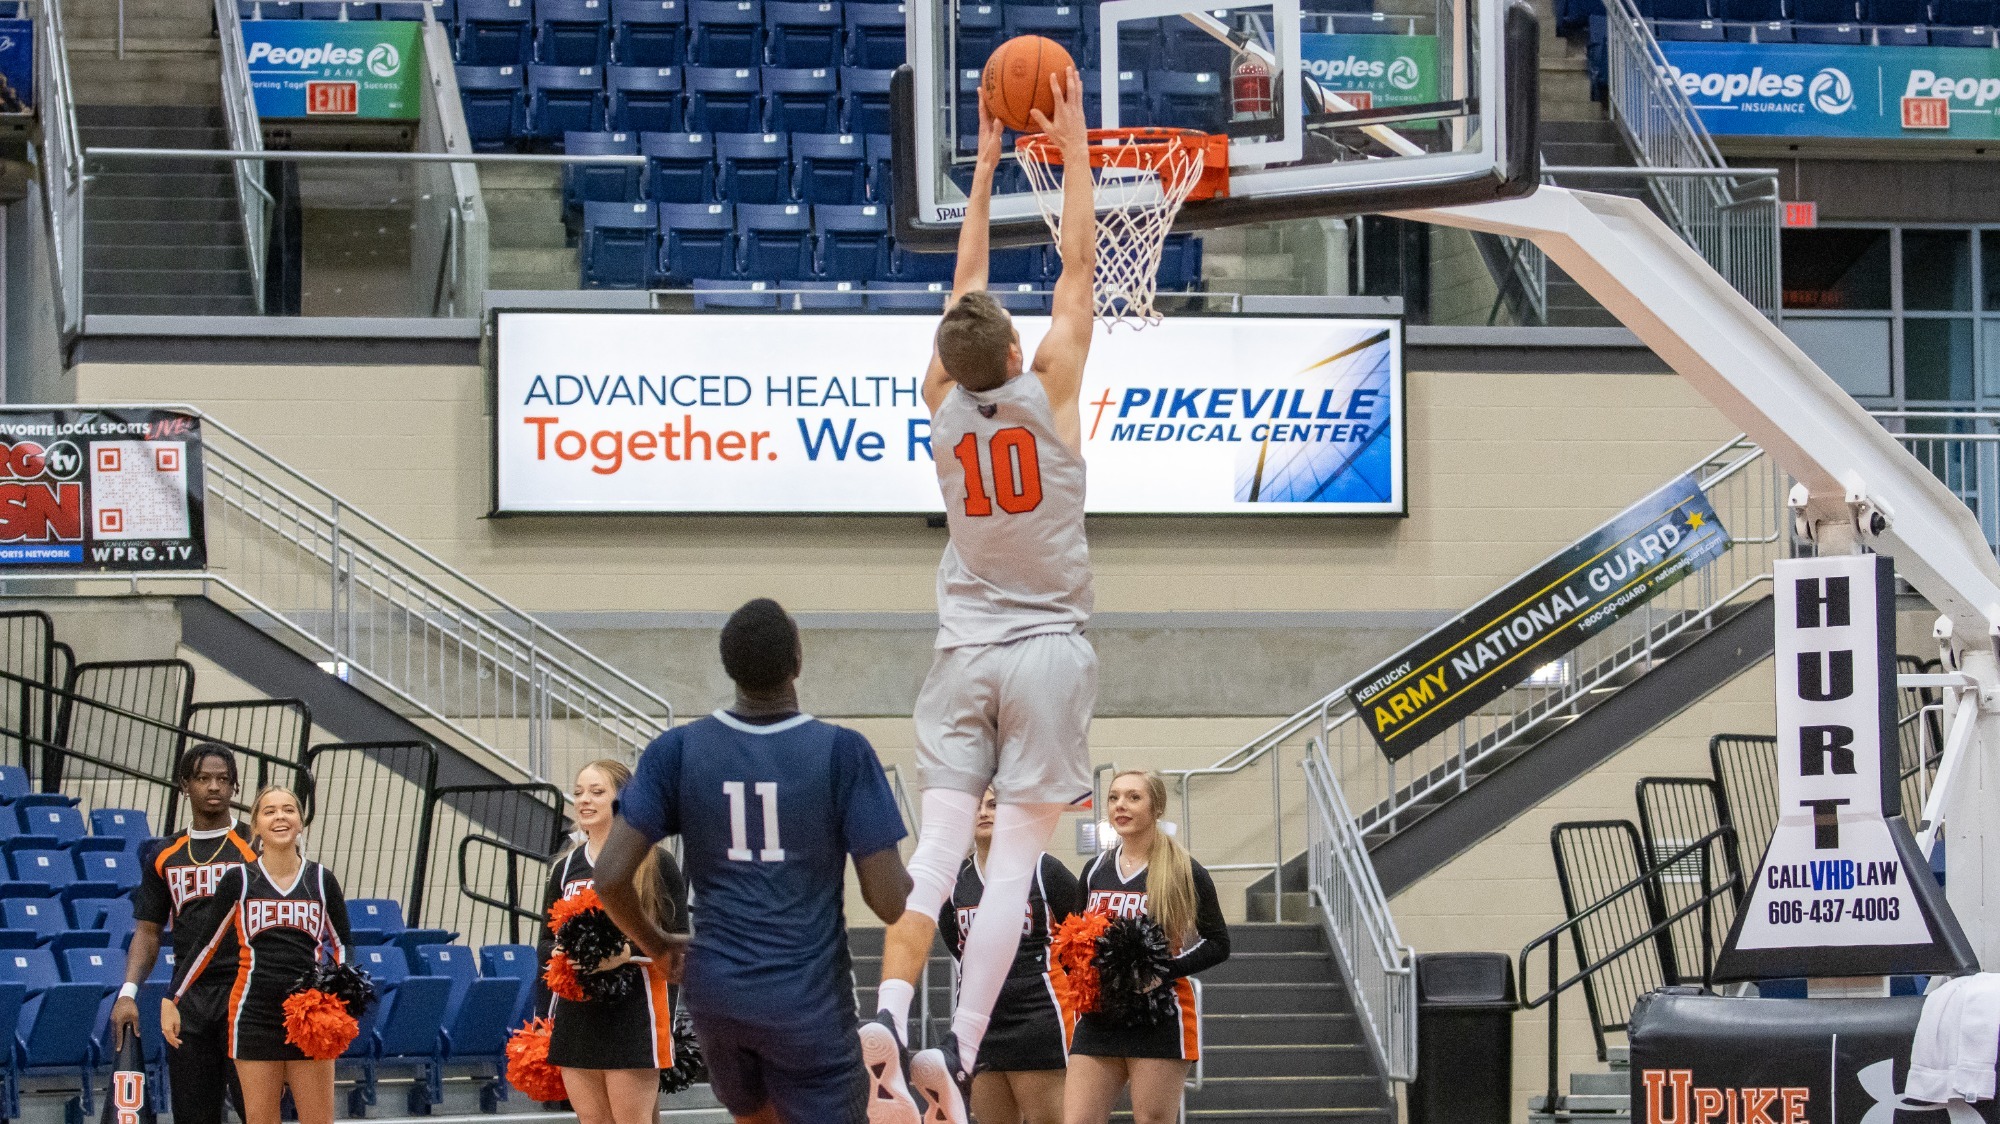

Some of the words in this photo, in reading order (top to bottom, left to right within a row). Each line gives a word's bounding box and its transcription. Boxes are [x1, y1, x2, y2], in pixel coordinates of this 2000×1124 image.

[248, 42, 365, 69] Peoples
[1301, 55, 1385, 80] eoples
[324, 68, 364, 76] BANK
[1347, 80, 1385, 88] BANK
[1656, 65, 1804, 103] Peoples
[1905, 69, 2000, 106] Peop
[315, 85, 351, 111] EXIT
[1741, 102, 1805, 113] INSURANCE
[1909, 101, 1942, 125] EXIT
[1786, 204, 1813, 226] EXIT
[523, 374, 752, 406] ADVANCED
[766, 376, 926, 407] HEALTH
[1118, 387, 1380, 420] PIKEVILLE
[0, 424, 53, 436] AVORITE
[57, 424, 98, 435] LOCAL
[100, 422, 151, 435] SPORTS
[523, 414, 778, 475] Together.
[797, 418, 885, 461] We
[1110, 423, 1242, 442] MEDICAL
[1249, 423, 1372, 444] CENTER
[953, 426, 1043, 517] 10
[0, 550, 24, 558] ORTS
[25, 550, 70, 558] NETWORK
[91, 546, 192, 562] WPRG.TV
[1578, 583, 1647, 632] 1-800-GO-GUARD
[1372, 666, 1449, 733] ARMY
[1451, 584, 1589, 681] NATIONAL
[1588, 523, 1680, 592] GUARD
[1355, 661, 1412, 702] KENTUCKY
[1795, 575, 1858, 850] HURT
[722, 780, 785, 862] 11
[166, 862, 240, 914] BEAR
[247, 900, 322, 939] BEARS
[1767, 896, 1900, 925] 606-437-4003
